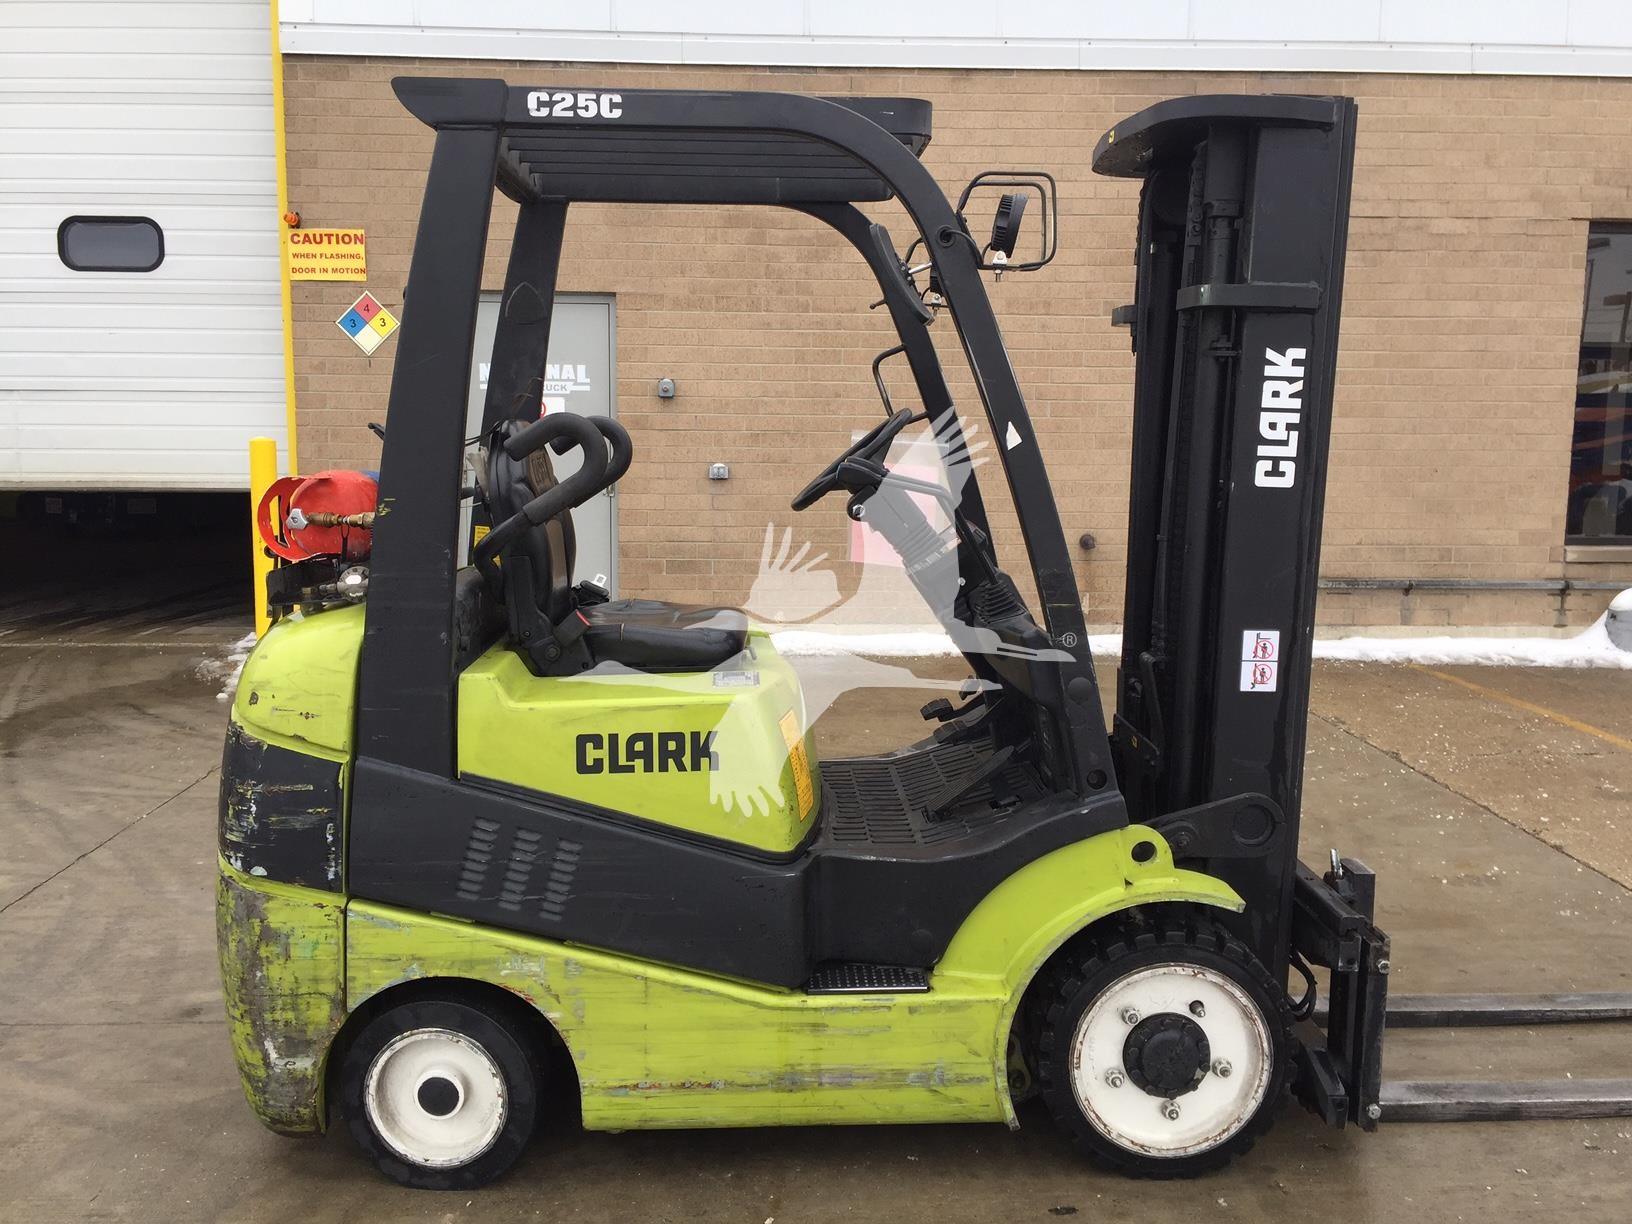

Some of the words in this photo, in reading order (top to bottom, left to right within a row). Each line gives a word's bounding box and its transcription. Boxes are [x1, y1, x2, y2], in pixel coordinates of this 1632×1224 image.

[527, 91, 623, 119] C25C
[290, 233, 364, 245] CAUTION
[292, 252, 317, 260] WHEN
[319, 252, 364, 261] FLASHING,
[331, 267, 366, 275] MOTION
[363, 304, 370, 313] 4
[350, 318, 357, 328] 3
[380, 318, 387, 327] 3
[1254, 347, 1307, 488] CLARK
[575, 730, 720, 775] CLARK
